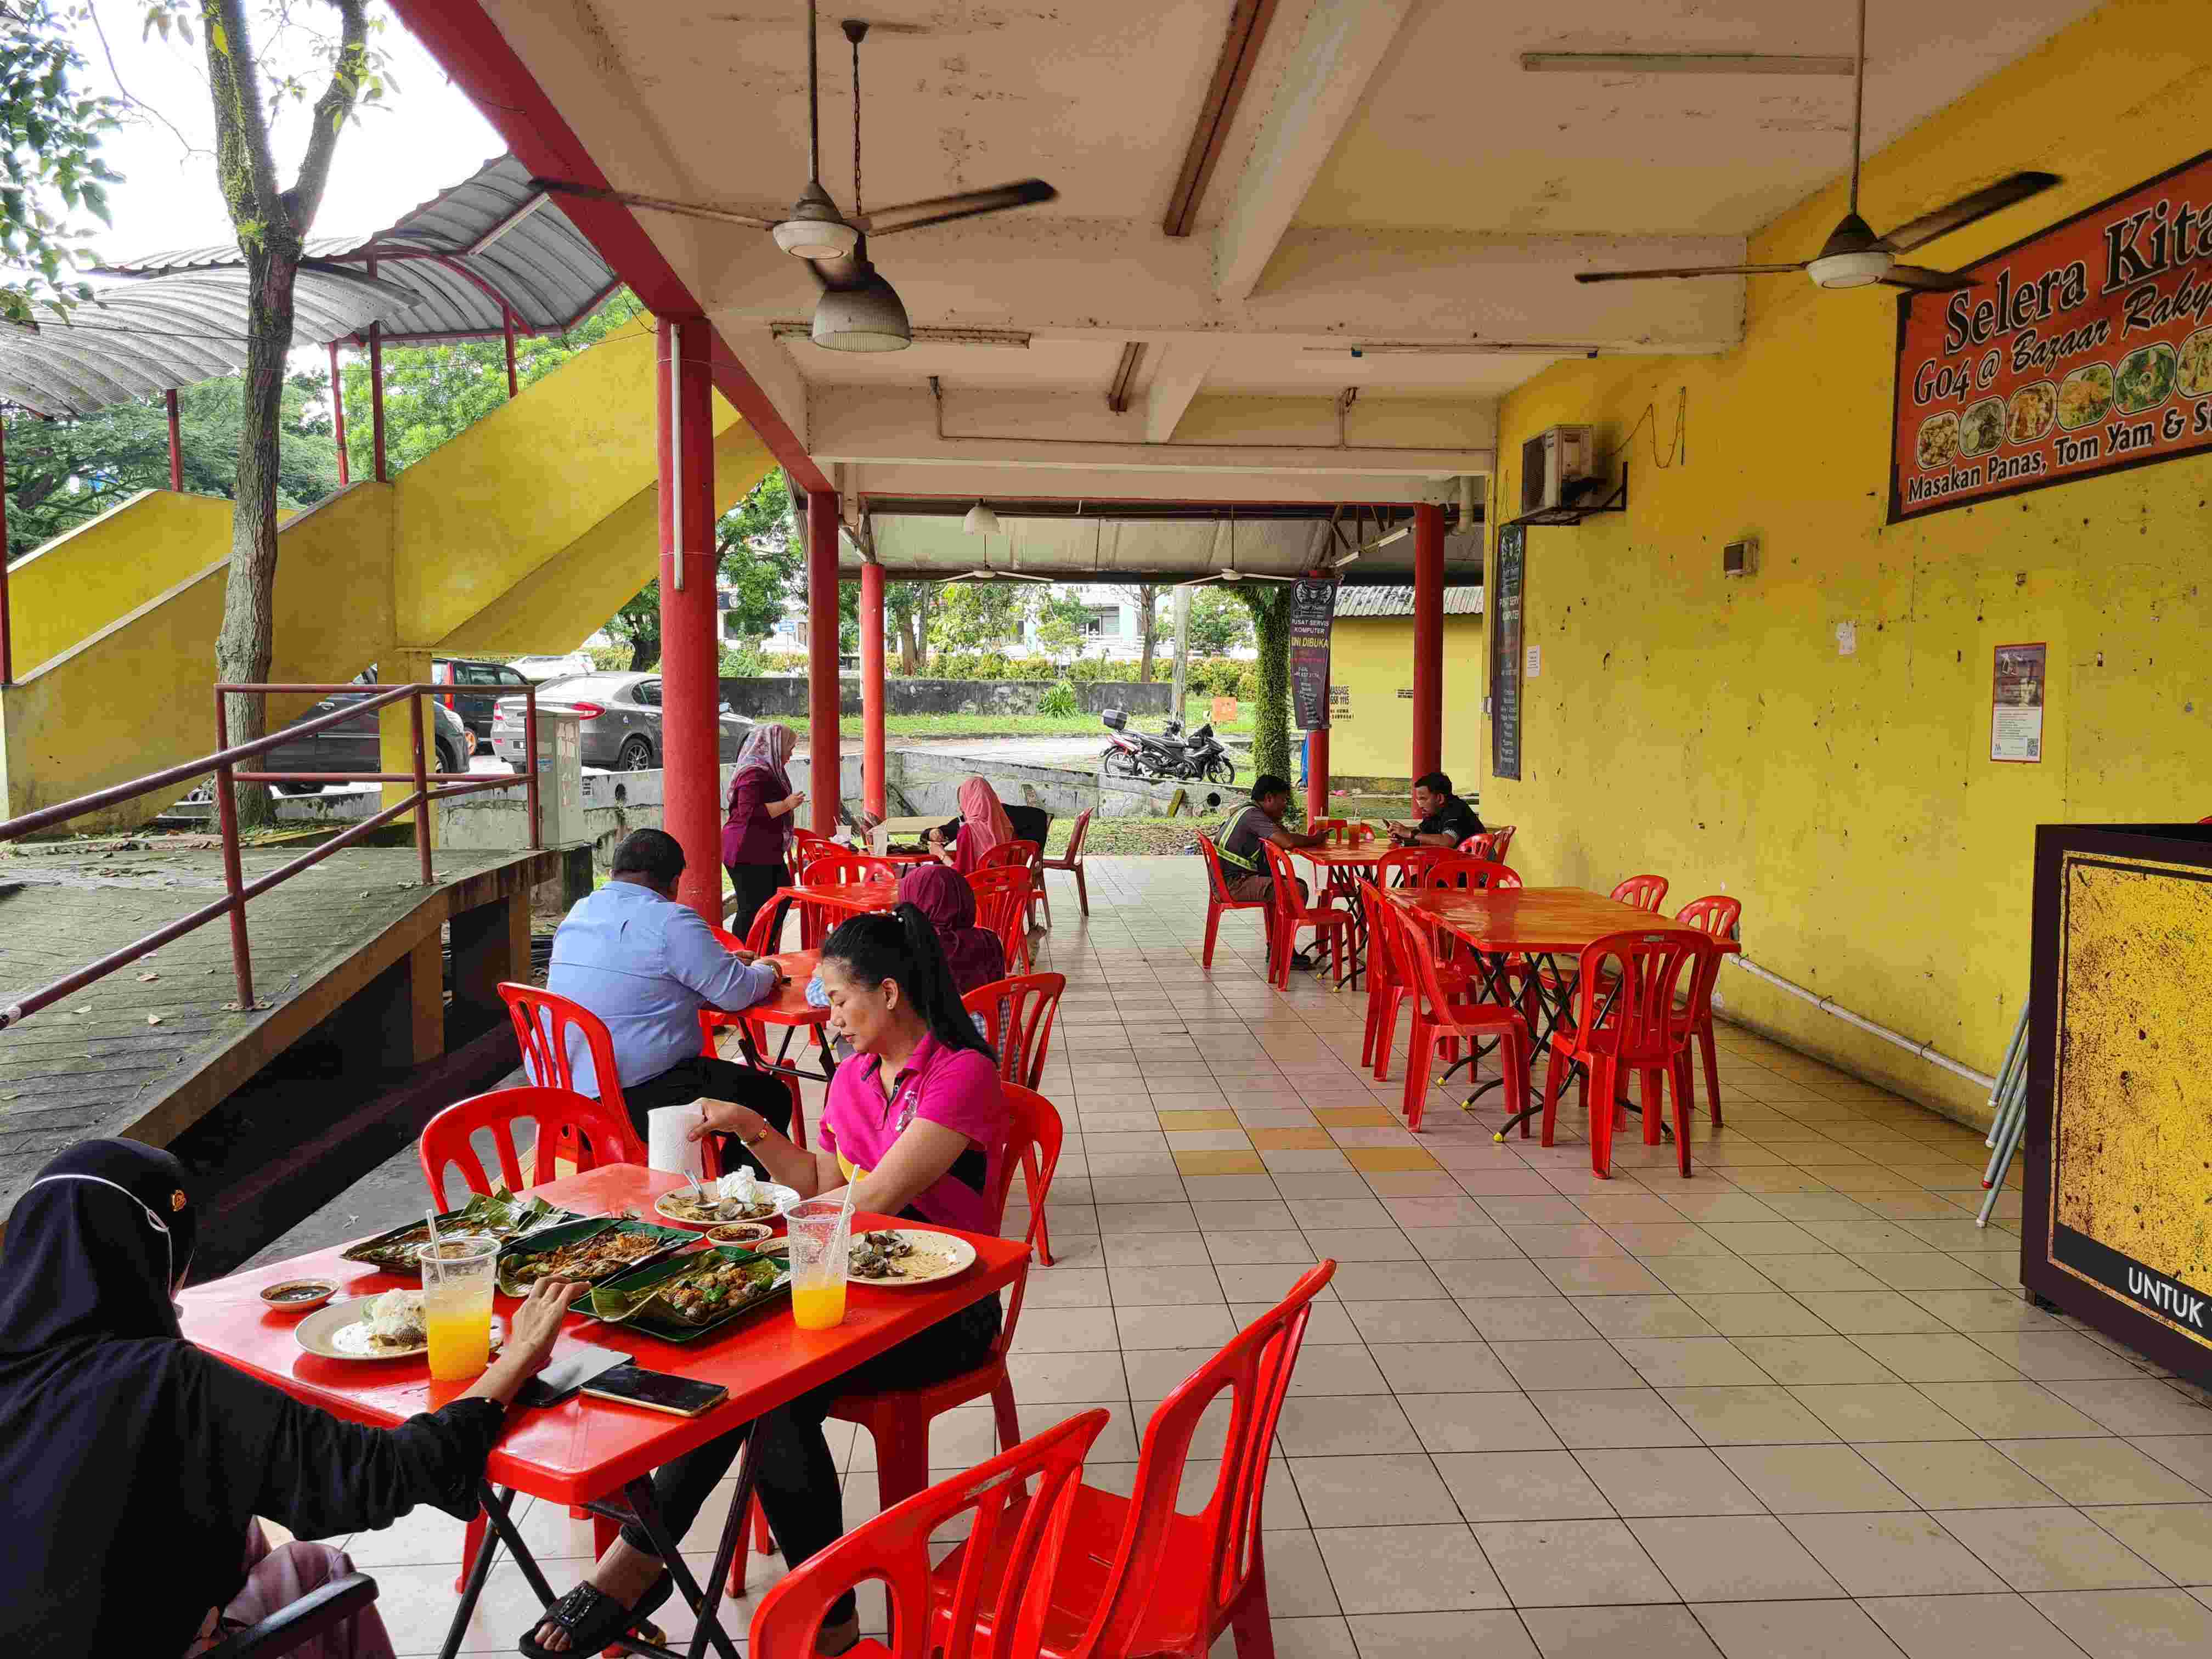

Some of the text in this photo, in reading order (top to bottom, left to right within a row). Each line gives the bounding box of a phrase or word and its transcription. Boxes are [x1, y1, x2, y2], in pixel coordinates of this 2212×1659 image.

[1945, 260, 2090, 355] Selera
[1975, 347, 2001, 391] @
[2012, 317, 2111, 377] Bazaar
[1906, 399, 2212, 504] Masakan Panas, Tom Yam & S
[1330, 685, 1350, 695] ASSAGE
[2129, 1266, 2205, 1328] UNTUK
